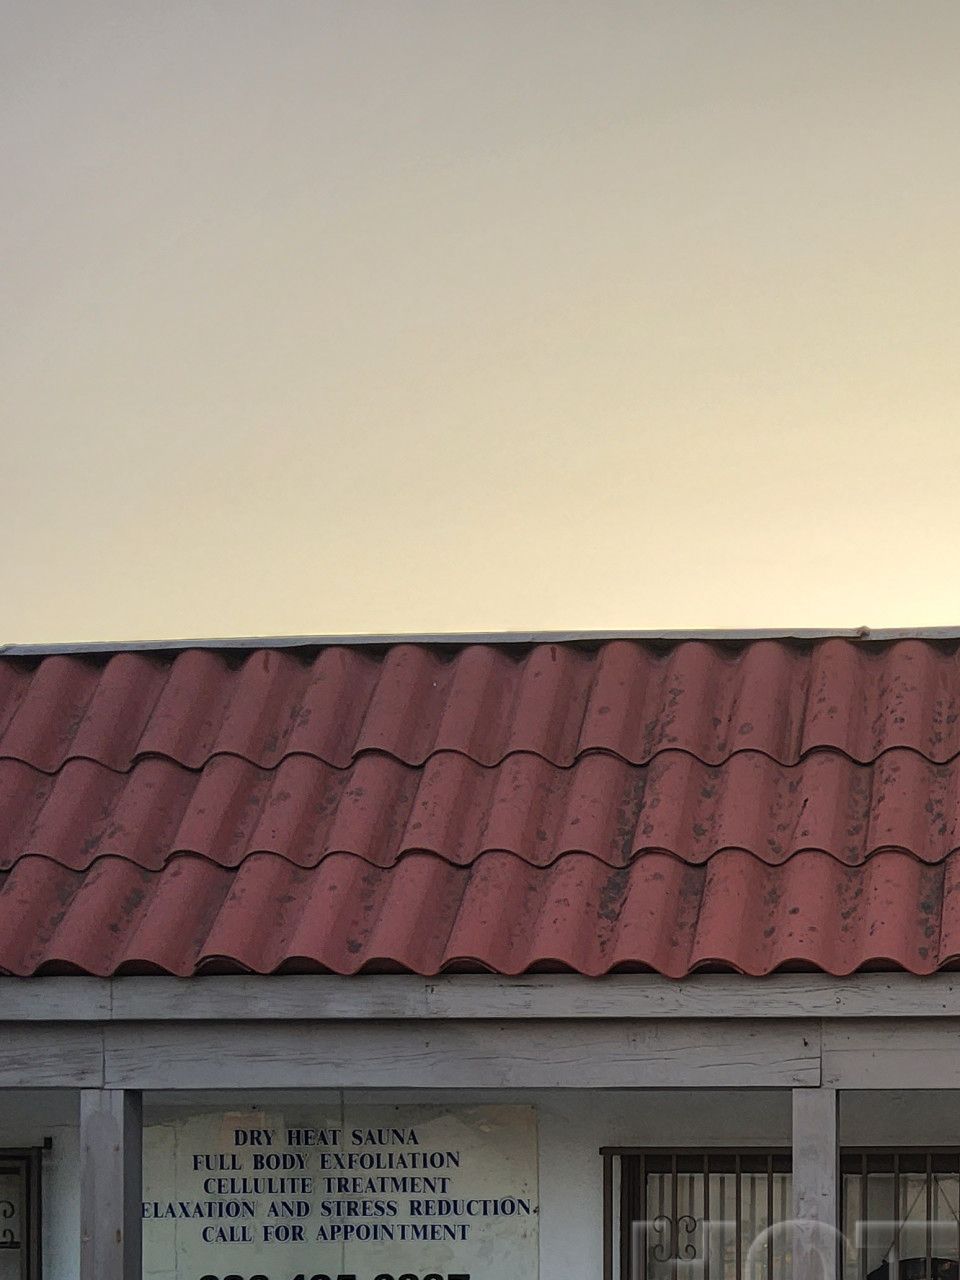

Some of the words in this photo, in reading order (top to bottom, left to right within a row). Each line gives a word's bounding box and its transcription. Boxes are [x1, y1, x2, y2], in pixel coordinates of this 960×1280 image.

[234, 1129, 276, 1147] DRY
[287, 1129, 341, 1146] HEAT
[351, 1128, 419, 1146] SAUNA
[193, 1154, 242, 1171] FULL
[253, 1153, 311, 1171] BODY
[320, 1151, 461, 1170] EXFOLIATION
[203, 1177, 312, 1194] CELLULITE
[323, 1176, 452, 1194] TREATMENT
[141, 1200, 256, 1219] ELAXATION
[267, 1200, 311, 1218] AND
[320, 1199, 398, 1218] STRESS
[409, 1197, 532, 1217] REDUCTION
[202, 1225, 253, 1243] CALL
[263, 1225, 305, 1242] FOR
[316, 1223, 471, 1242] APPOINTMENT
